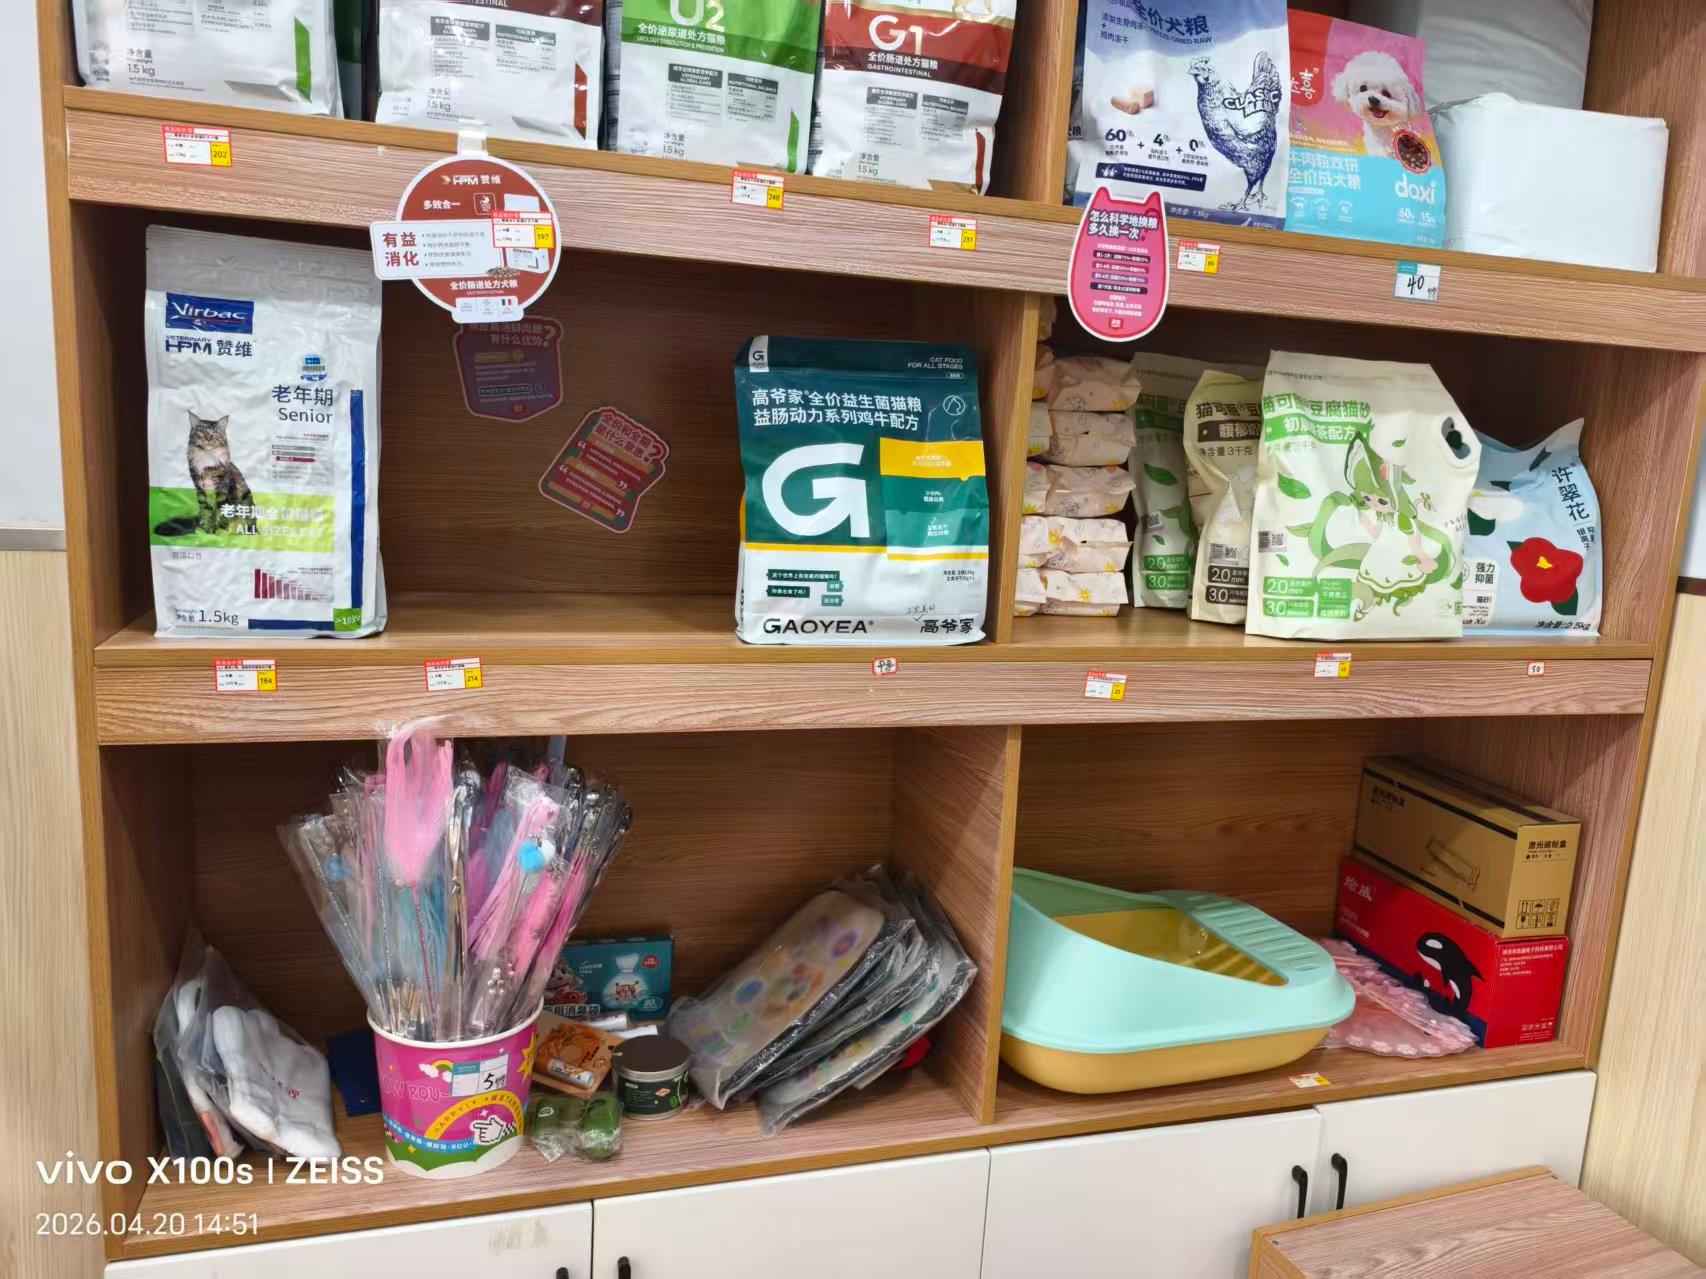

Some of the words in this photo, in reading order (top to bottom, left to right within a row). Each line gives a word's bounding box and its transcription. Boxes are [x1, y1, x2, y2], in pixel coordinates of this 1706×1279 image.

[142, 65, 155, 78] kg
[868, 63, 932, 77] GASTROINTESTINAL
[213, 151, 227, 159] 202
[1395, 173, 1436, 205] doxi
[423, 200, 461, 210] 多效合一
[1089, 210, 1158, 229] 怎么科学地换粮
[383, 232, 417, 248] 有益
[1088, 223, 1139, 241] 多久换一次
[385, 251, 420, 267] 消化
[1407, 273, 1425, 295] 40
[170, 301, 248, 321] Virbac
[165, 340, 213, 356] HPM
[216, 339, 254, 358] 赞维
[272, 384, 335, 407] 老年期
[278, 407, 335, 425] Senior
[754, 408, 919, 430] 益肠动力系列鸡牛配方
[1552, 465, 1590, 523] 许翠花
[1211, 568, 1231, 582] 2.0
[1475, 562, 1496, 573] 强力
[1267, 579, 1289, 594] 2.0
[1474, 573, 1494, 585] 抑菌
[1209, 588, 1229, 602] 3.0
[1266, 600, 1286, 615] 3.0
[198, 609, 240, 626] 1.5kg
[920, 618, 974, 634] 高爷家
[260, 677, 273, 685] 184
[1528, 841, 1567, 849] 激光碳粉盒
